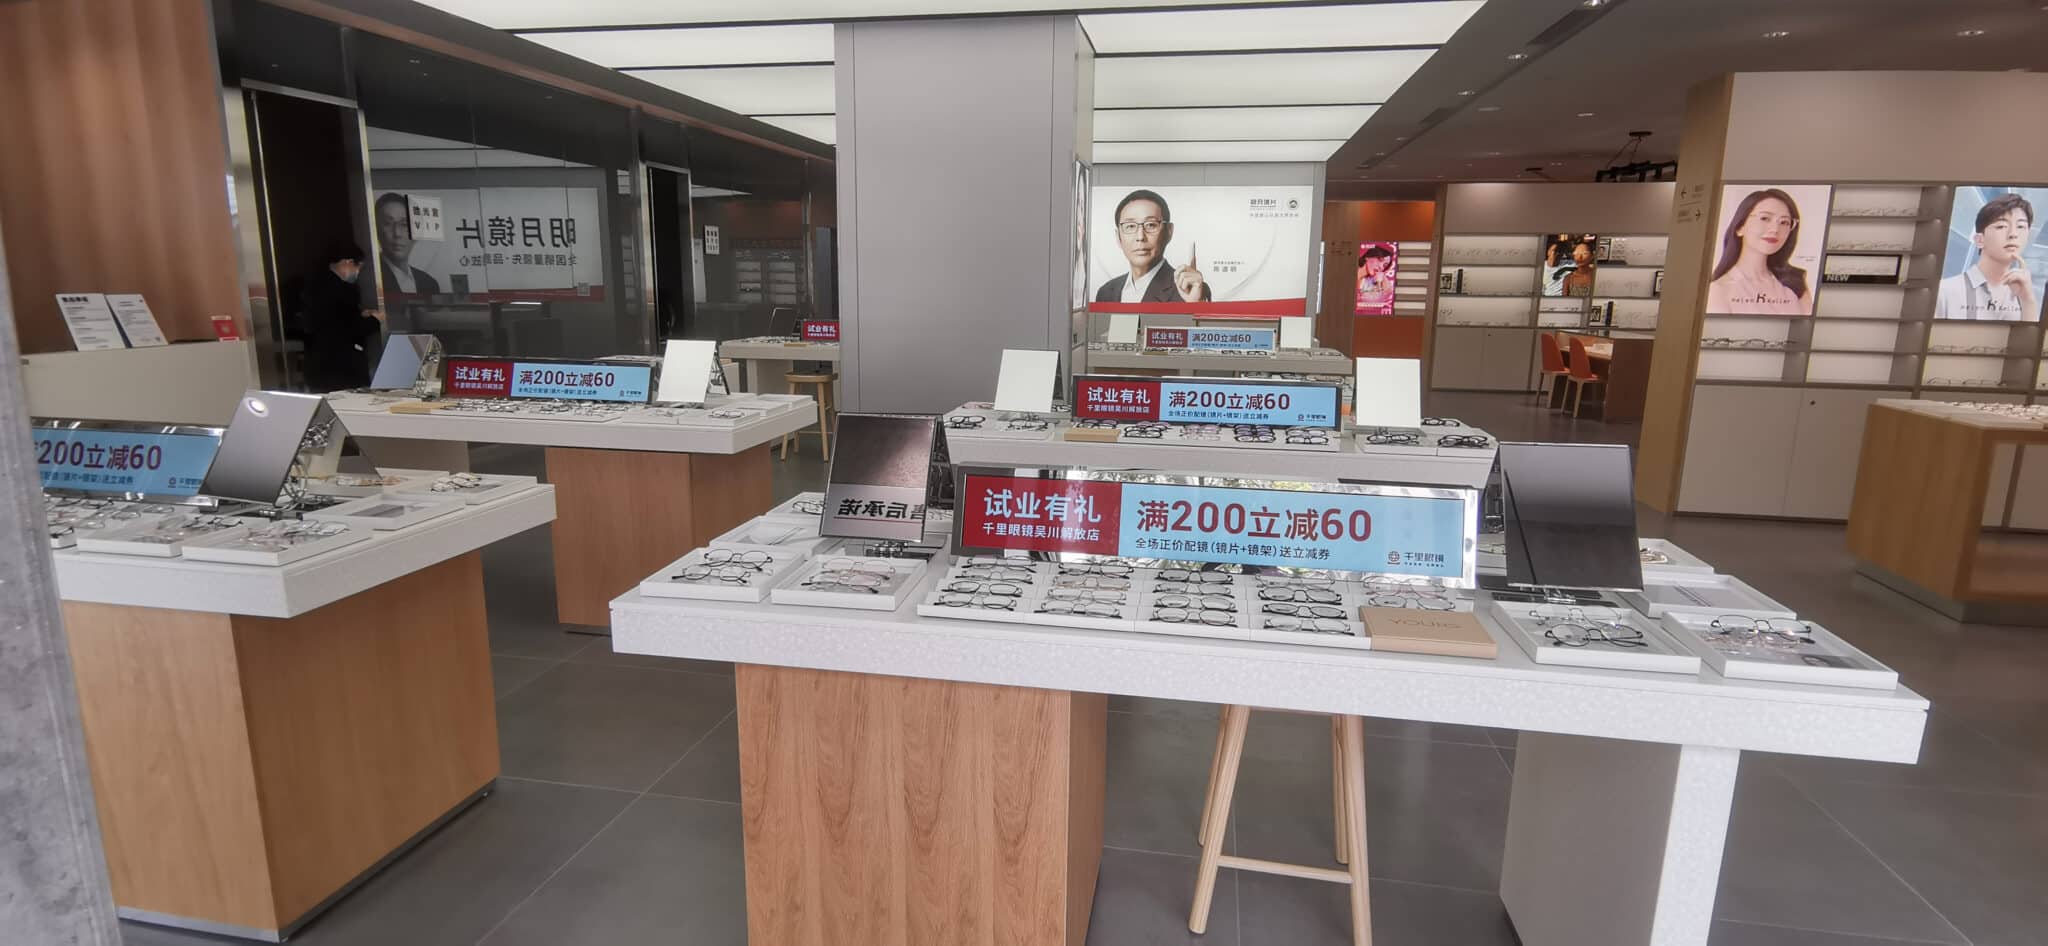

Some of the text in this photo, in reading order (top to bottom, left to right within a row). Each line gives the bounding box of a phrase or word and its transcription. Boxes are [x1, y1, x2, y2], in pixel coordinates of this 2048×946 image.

[415, 221, 440, 231] VIP
[454, 366, 506, 382] 试业有礼
[519, 370, 615, 387] 满200立减60
[1087, 386, 1151, 404] 试业有礼
[1168, 390, 1291, 410] 满200立减60
[34, 440, 162, 471] 200立减60
[983, 488, 1102, 523] 试业有礼
[1136, 499, 1372, 542] 满200立减60
[982, 521, 1100, 542] 千里眼镜吴川解放店
